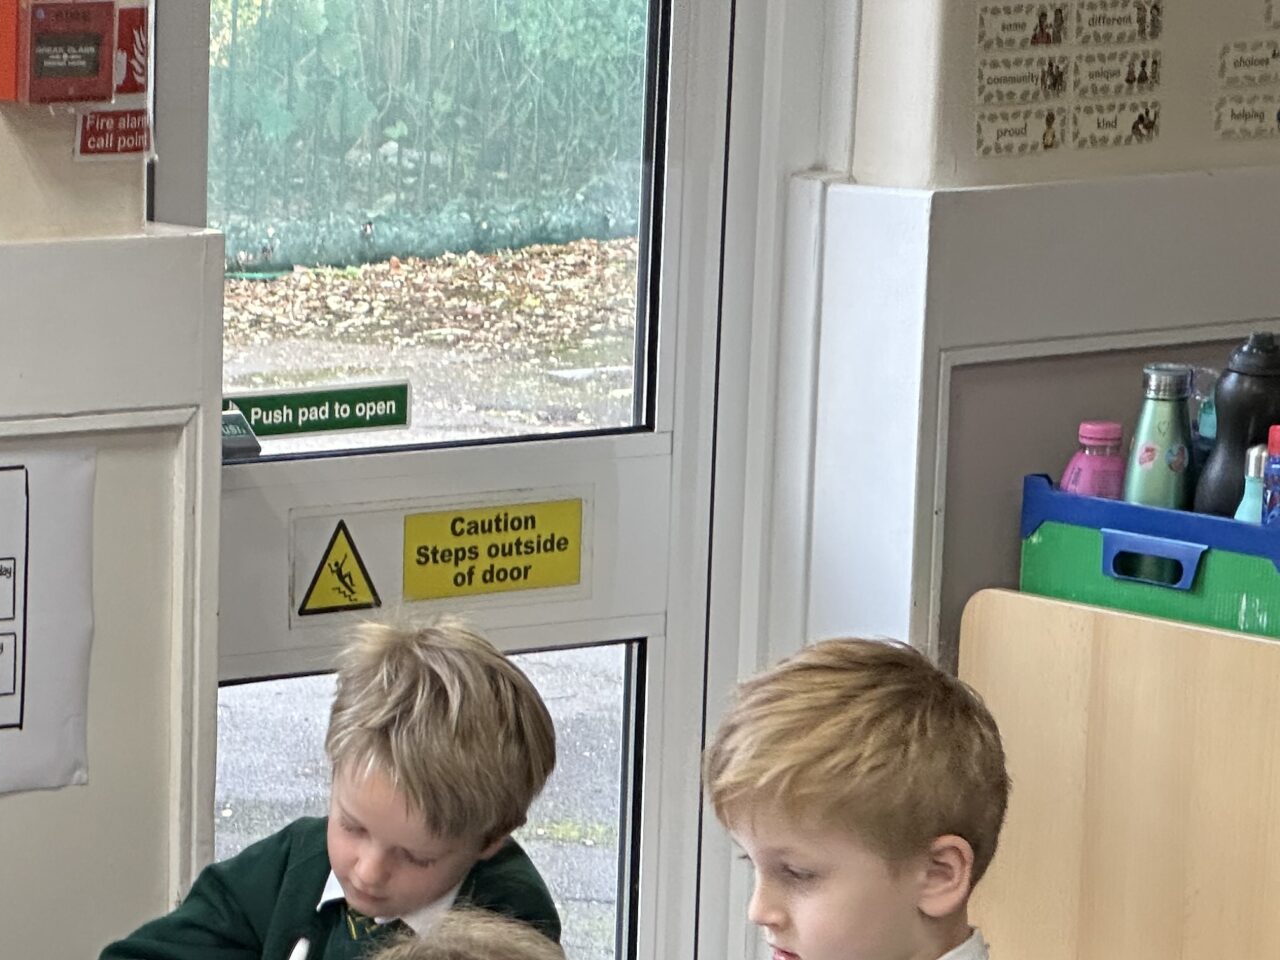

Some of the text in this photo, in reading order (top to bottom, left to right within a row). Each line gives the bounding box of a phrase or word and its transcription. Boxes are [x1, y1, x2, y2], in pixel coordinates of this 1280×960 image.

[1088, 14, 1132, 28] different
[987, 72, 1040, 86] community
[86, 114, 115, 132] Fire
[1096, 116, 1118, 131] kind
[1230, 107, 1266, 124] helping
[87, 131, 148, 152] call point
[996, 124, 1028, 141] proud
[250, 398, 397, 427] Push pad to open
[450, 511, 537, 538] Caution
[415, 533, 570, 568] Steps outside
[453, 562, 533, 588] of door
